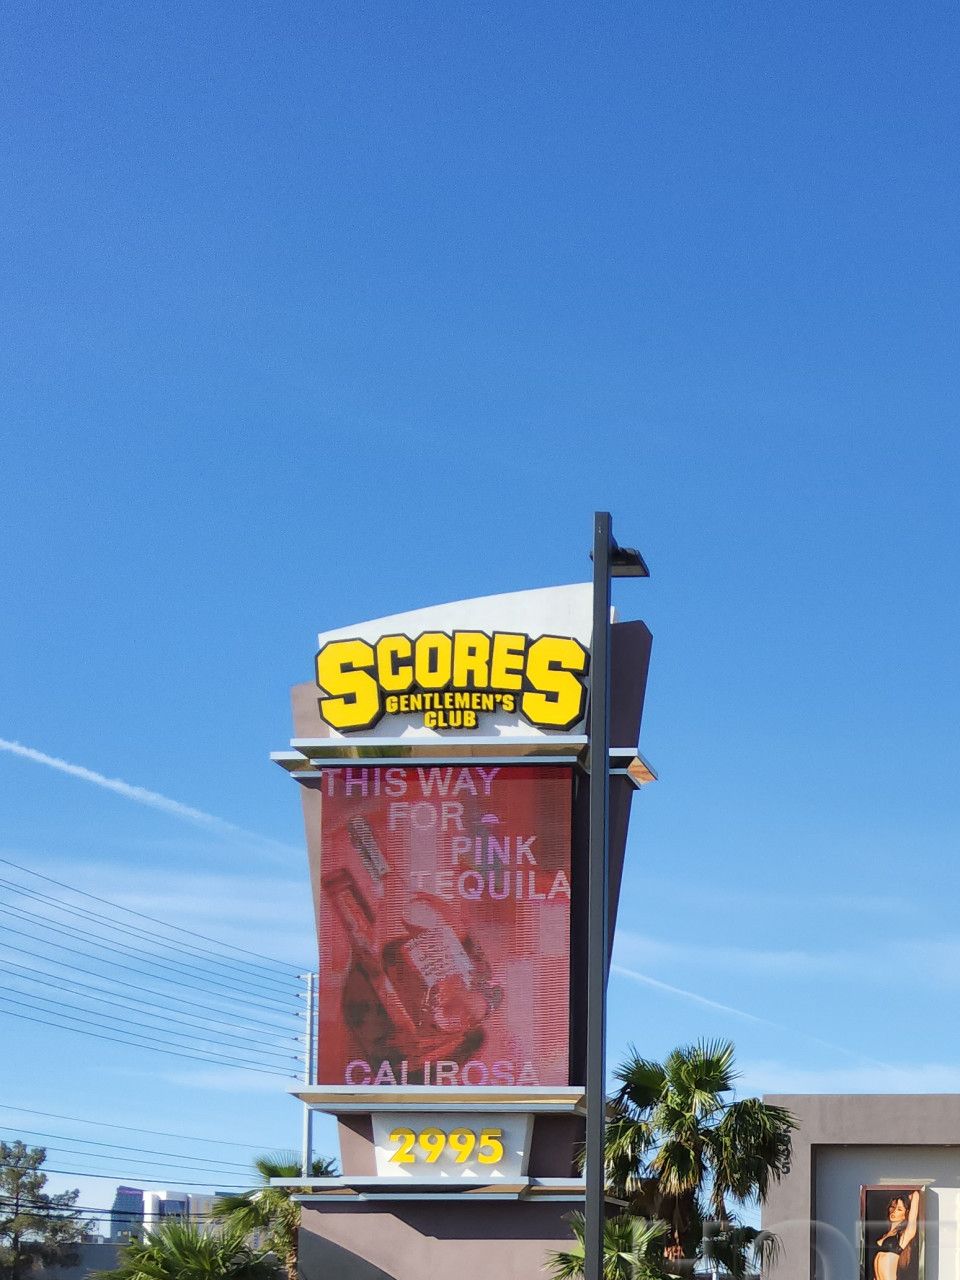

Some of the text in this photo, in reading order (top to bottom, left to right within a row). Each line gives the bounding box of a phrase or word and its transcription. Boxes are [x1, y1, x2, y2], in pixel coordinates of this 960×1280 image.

[315, 630, 590, 731] SCORES
[385, 691, 515, 713] GENTLEMEN'S
[423, 709, 477, 728] CLUB
[322, 767, 500, 797] THIS WAY
[387, 801, 465, 831] FOR
[451, 835, 538, 866] PINK
[411, 870, 571, 900] TEQUILA
[344, 1059, 540, 1086] CALIROSA
[388, 1126, 505, 1164] 2995
